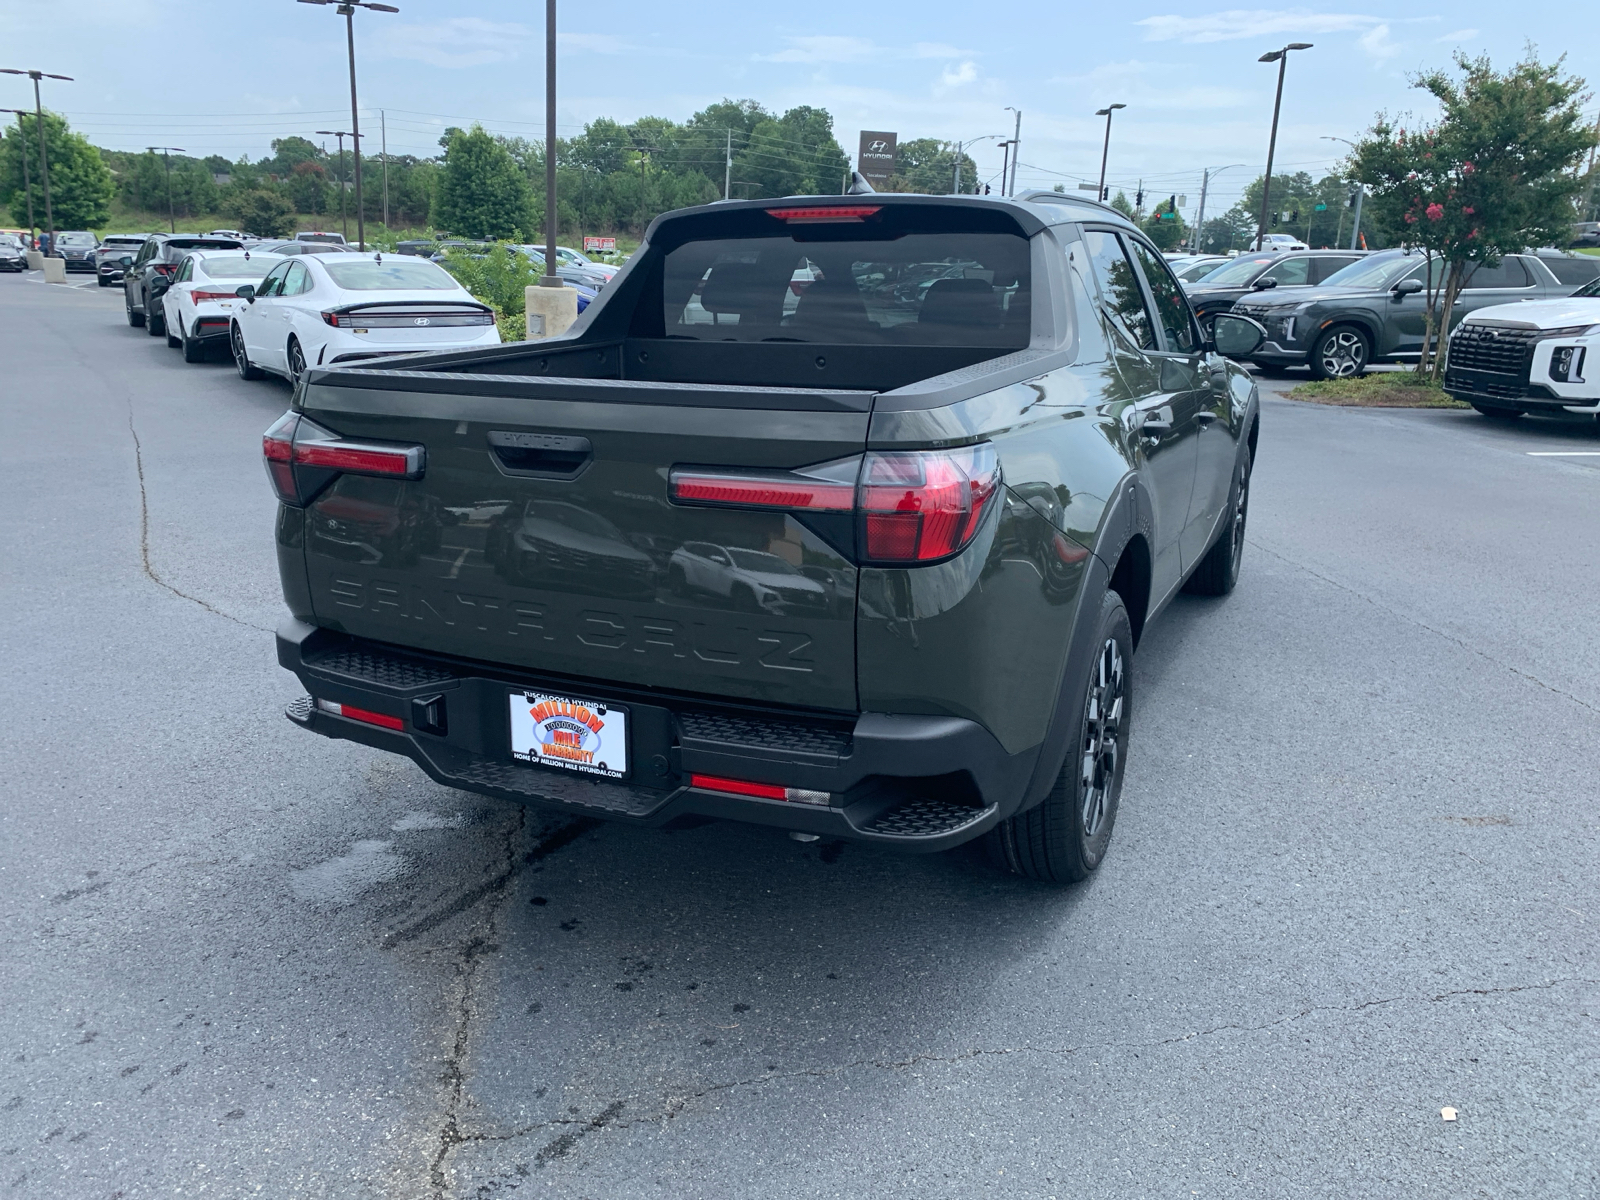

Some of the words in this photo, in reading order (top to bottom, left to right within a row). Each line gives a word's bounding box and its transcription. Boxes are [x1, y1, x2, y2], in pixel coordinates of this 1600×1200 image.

[330, 573, 555, 641] SANTA
[576, 608, 817, 673] CRUZ
[523, 691, 570, 704] TUSCALOOSA
[571, 699, 607, 710] HYUNDAI
[529, 700, 605, 735] MILLION
[553, 729, 582, 750] MILE
[541, 743, 594, 763] WARRANTY
[514, 753, 531, 761] HOME
[532, 755, 540, 763] OF
[541, 758, 564, 768] MILLION
[565, 763, 578, 771] MILE
[579, 766, 622, 778] HYUNDAI.COM
